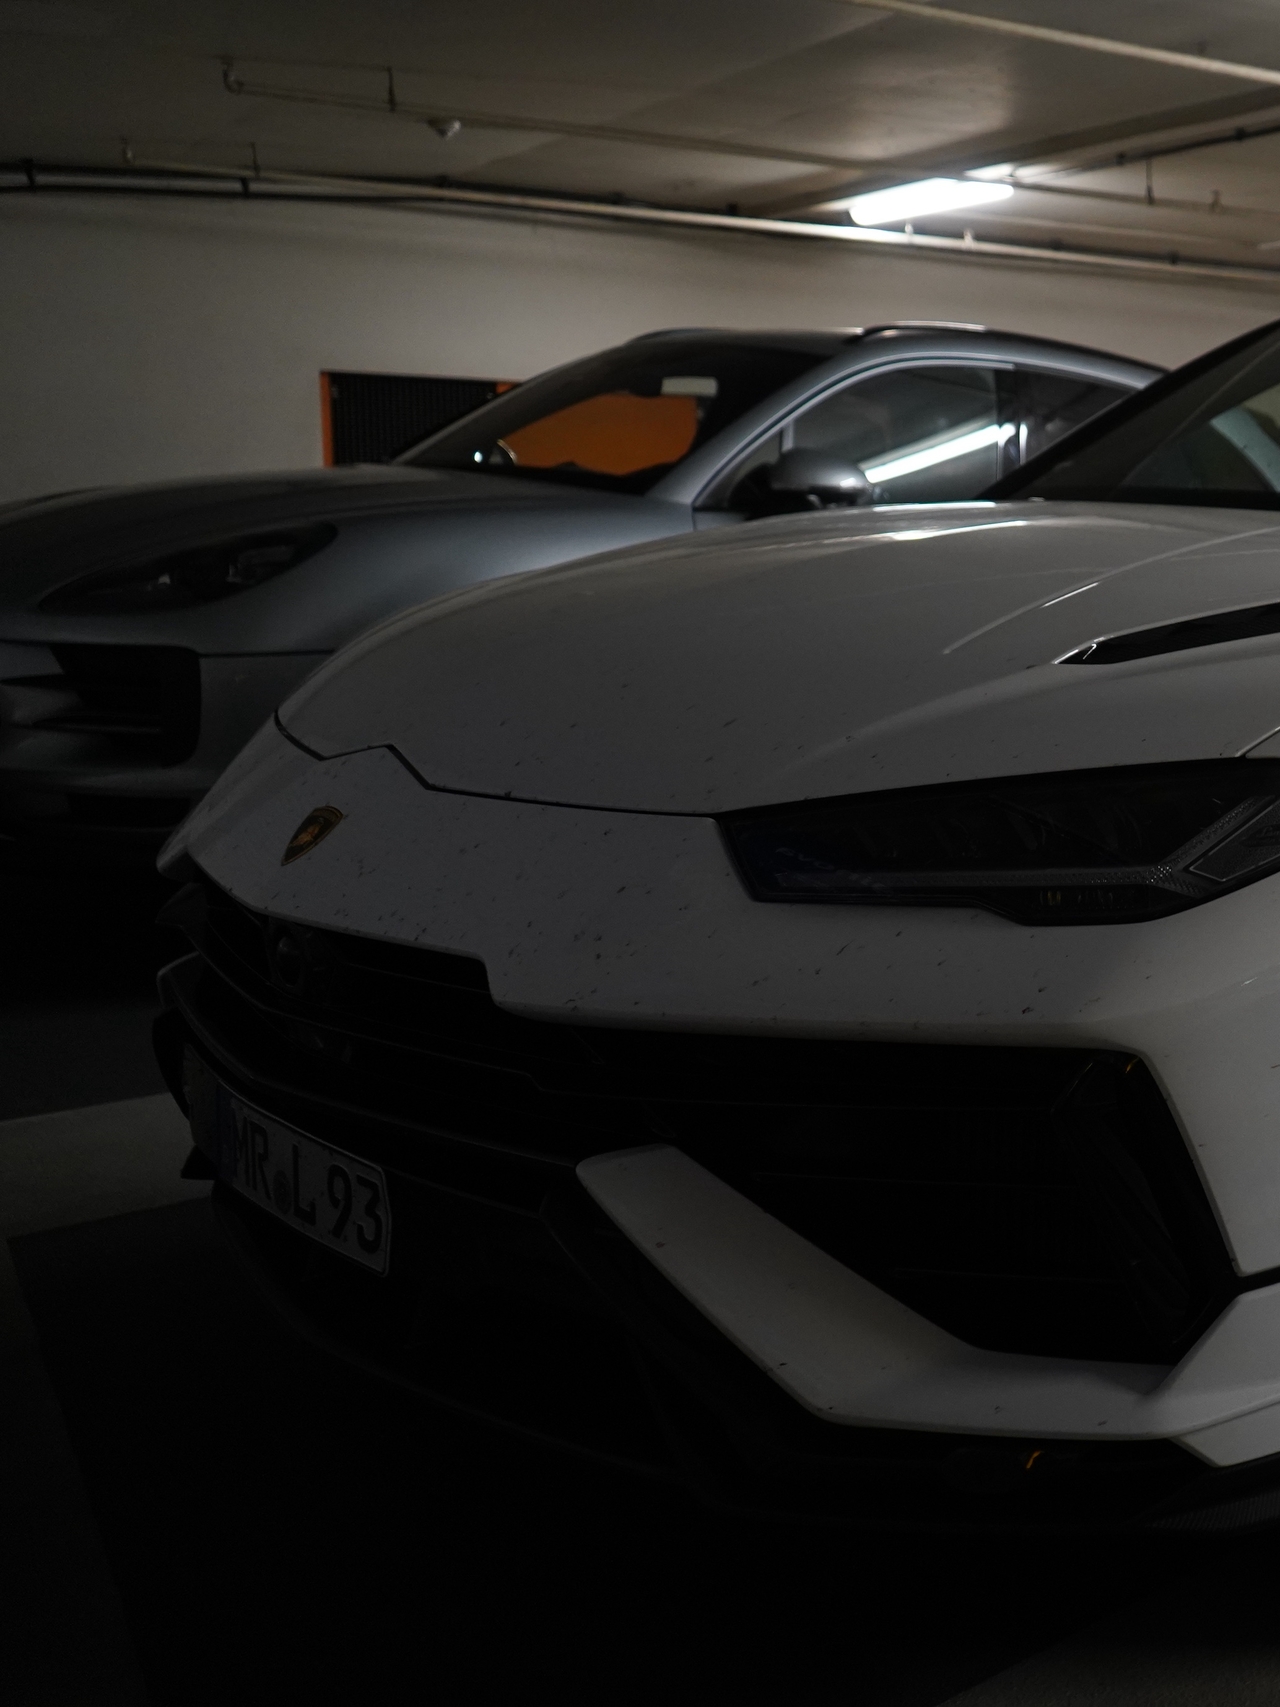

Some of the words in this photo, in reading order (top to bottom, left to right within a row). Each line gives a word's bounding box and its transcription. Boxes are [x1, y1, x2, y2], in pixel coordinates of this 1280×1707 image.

[234, 1114, 272, 1200] MR
[293, 1144, 316, 1226] L
[327, 1164, 382, 1254] 93
